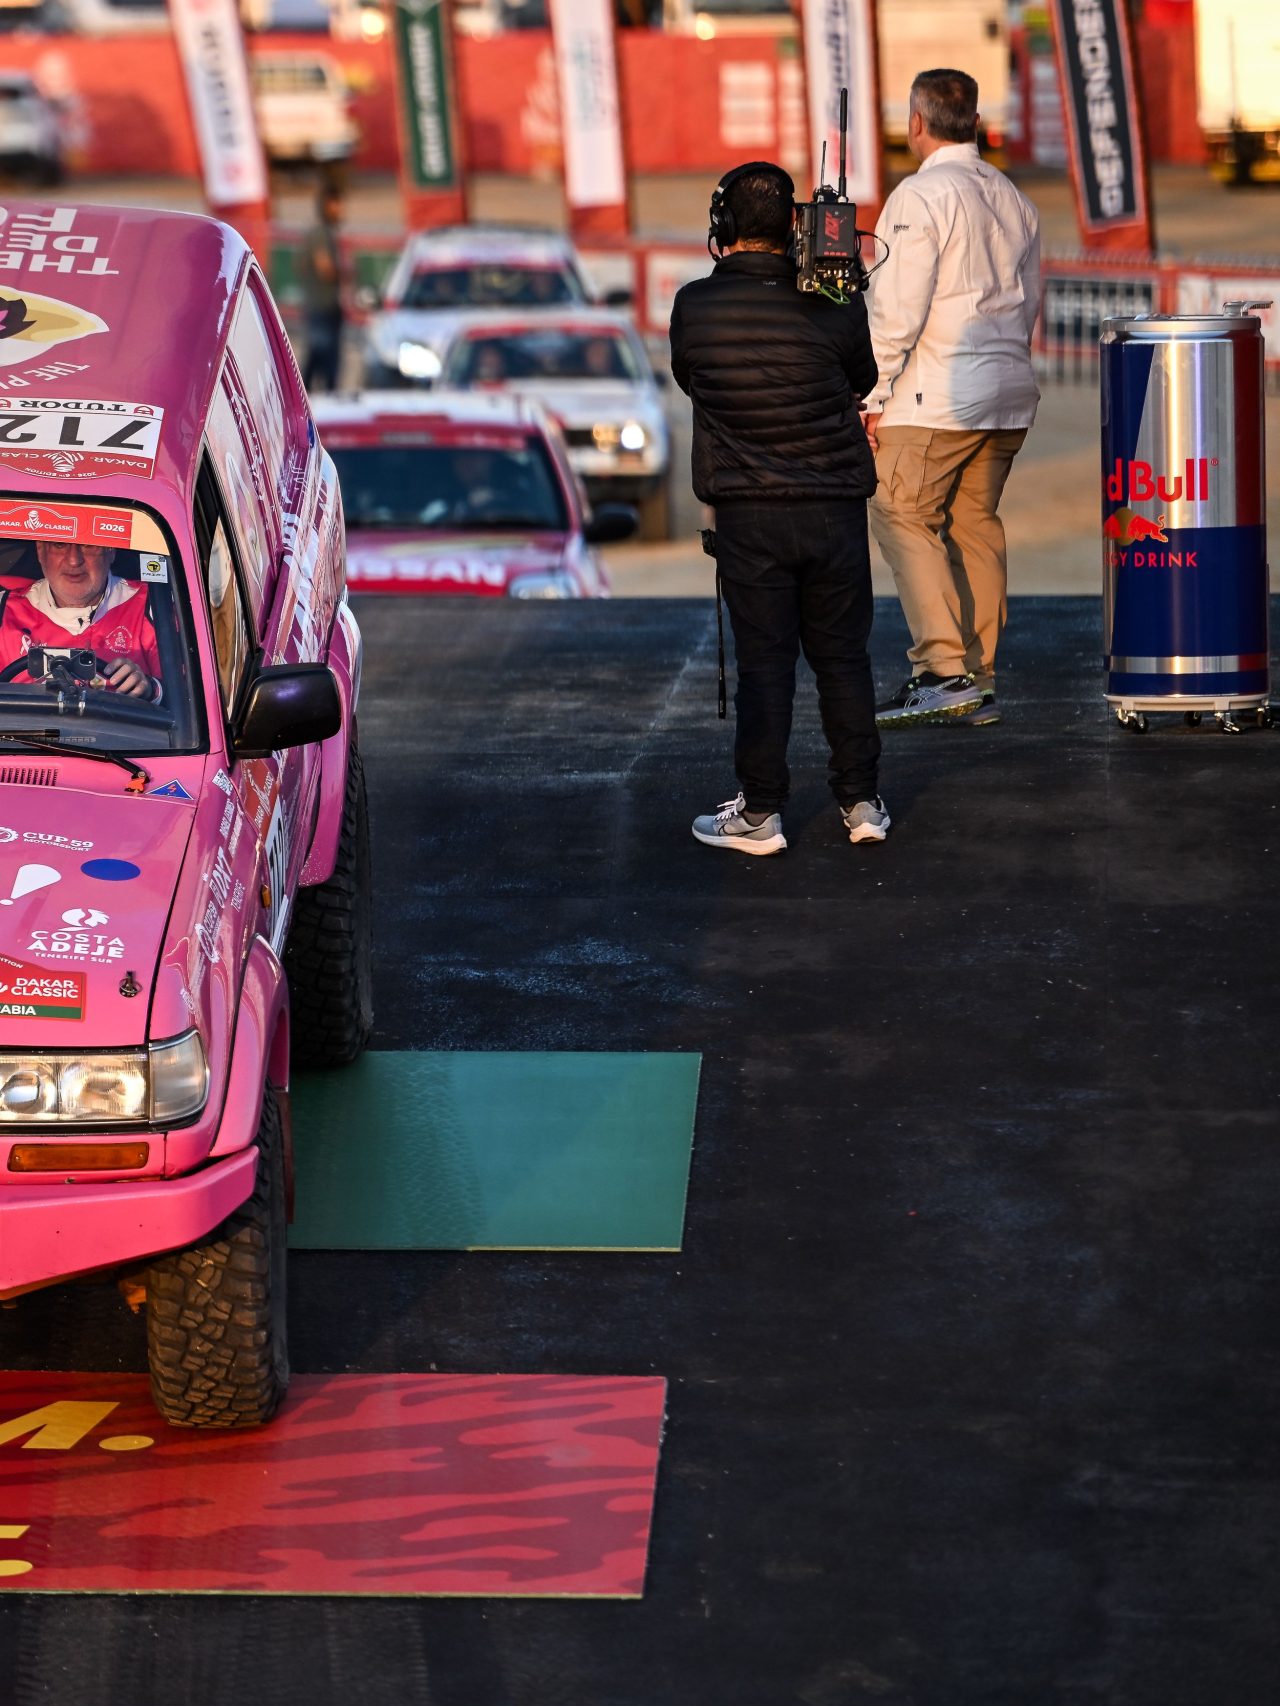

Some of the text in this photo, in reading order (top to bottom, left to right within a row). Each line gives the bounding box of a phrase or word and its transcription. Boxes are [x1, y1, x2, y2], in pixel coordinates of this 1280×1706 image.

[25, 361, 90, 380] THE
[20, 400, 126, 412] TUDOR
[94, 457, 147, 469] DAKAR
[25, 467, 57, 477] EDITION
[44, 523, 73, 531] CLASSIC
[99, 523, 125, 532] 2026
[1134, 552, 1198, 568] DRINK
[346, 555, 505, 587] ISSAN
[23, 832, 94, 848] CUP 59
[23, 838, 93, 852] MOTORSPORT
[31, 930, 125, 947] COSTA
[26, 940, 125, 959] ADEJE
[35, 952, 86, 961] TENERIFE
[16, 978, 75, 988] DAKAR
[11, 987, 79, 999] CLASSIC
